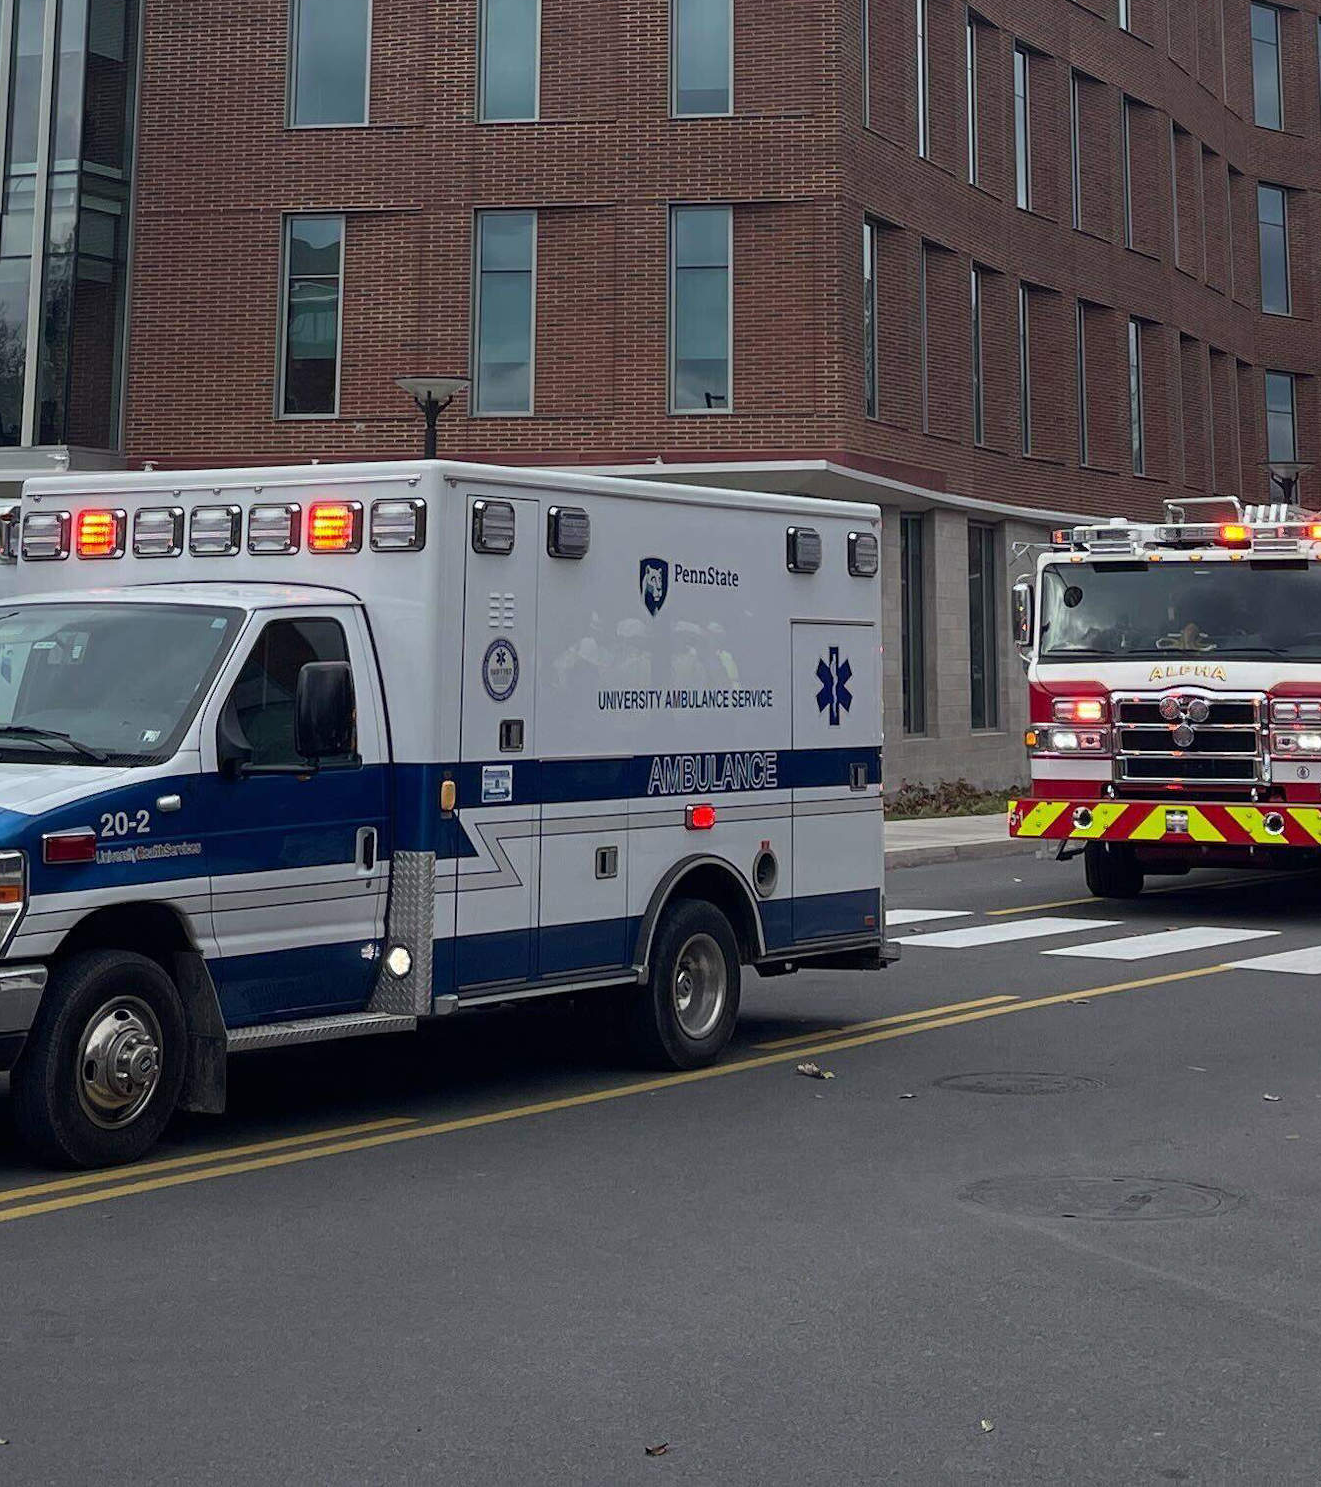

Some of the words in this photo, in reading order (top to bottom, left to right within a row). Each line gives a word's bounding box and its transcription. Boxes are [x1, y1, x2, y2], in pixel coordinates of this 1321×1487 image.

[674, 563, 739, 587] PennState
[1148, 665, 1227, 682] ALPHA
[598, 690, 662, 710] UNIVERSITY
[665, 689, 729, 709] AMBULANCE
[731, 689, 774, 708] SERVICE
[647, 751, 778, 795] AMBULANCE
[100, 809, 150, 837] 20-2
